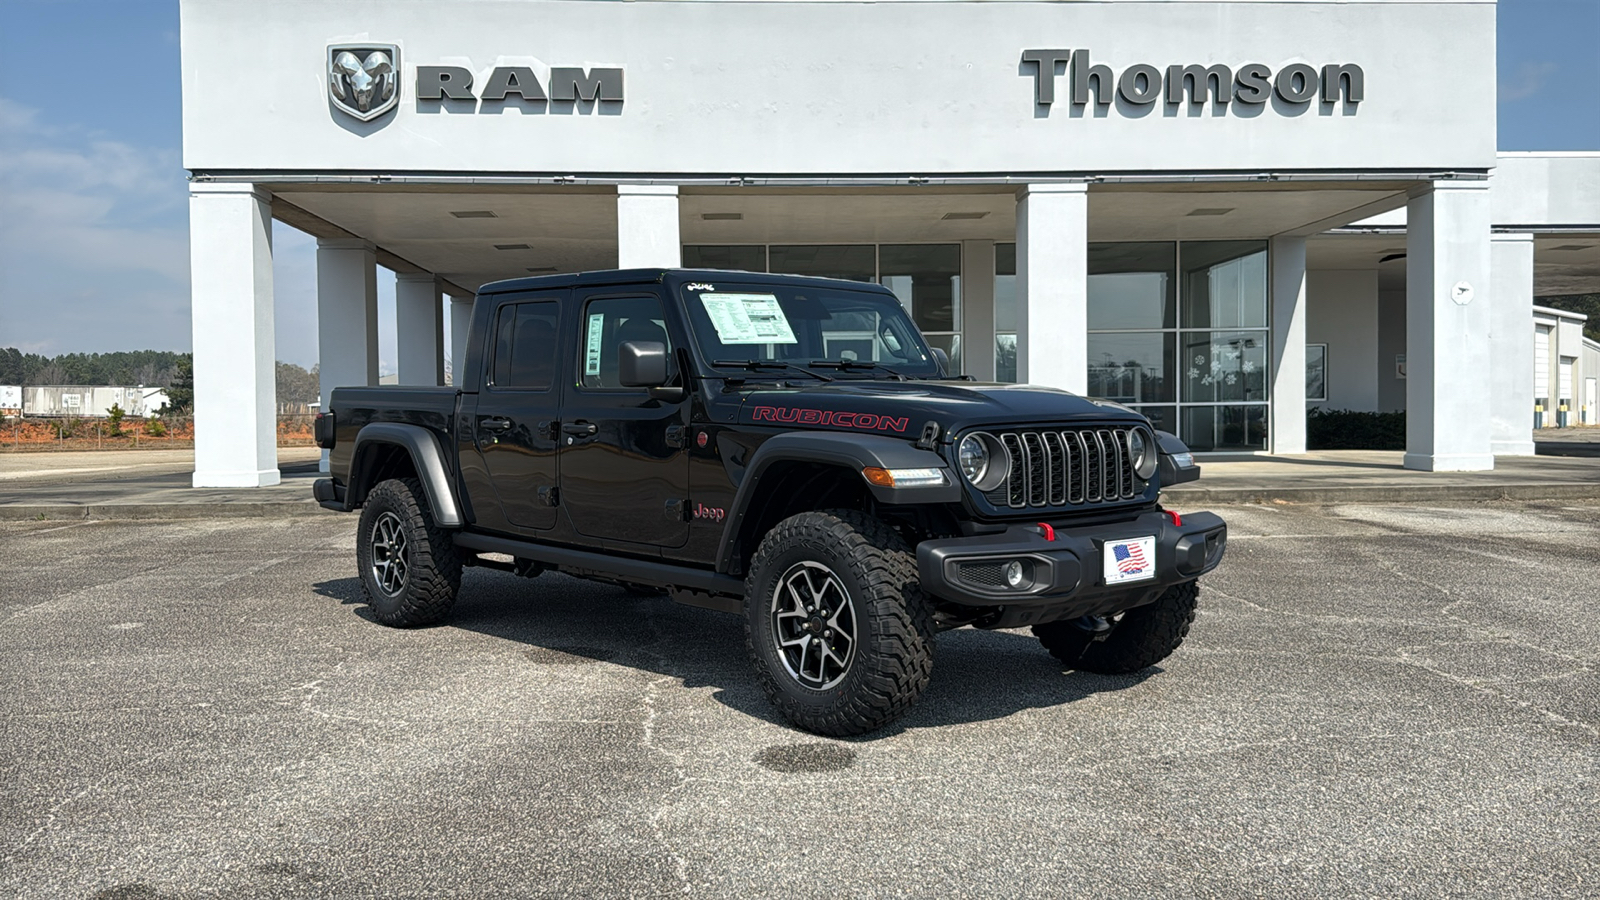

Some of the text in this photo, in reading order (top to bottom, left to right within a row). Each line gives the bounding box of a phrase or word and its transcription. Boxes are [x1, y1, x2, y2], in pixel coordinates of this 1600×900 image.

[416, 66, 624, 101] RAM
[1021, 48, 1364, 105] Thomson
[752, 405, 909, 432] RUBICON
[693, 503, 725, 522] Jeep
